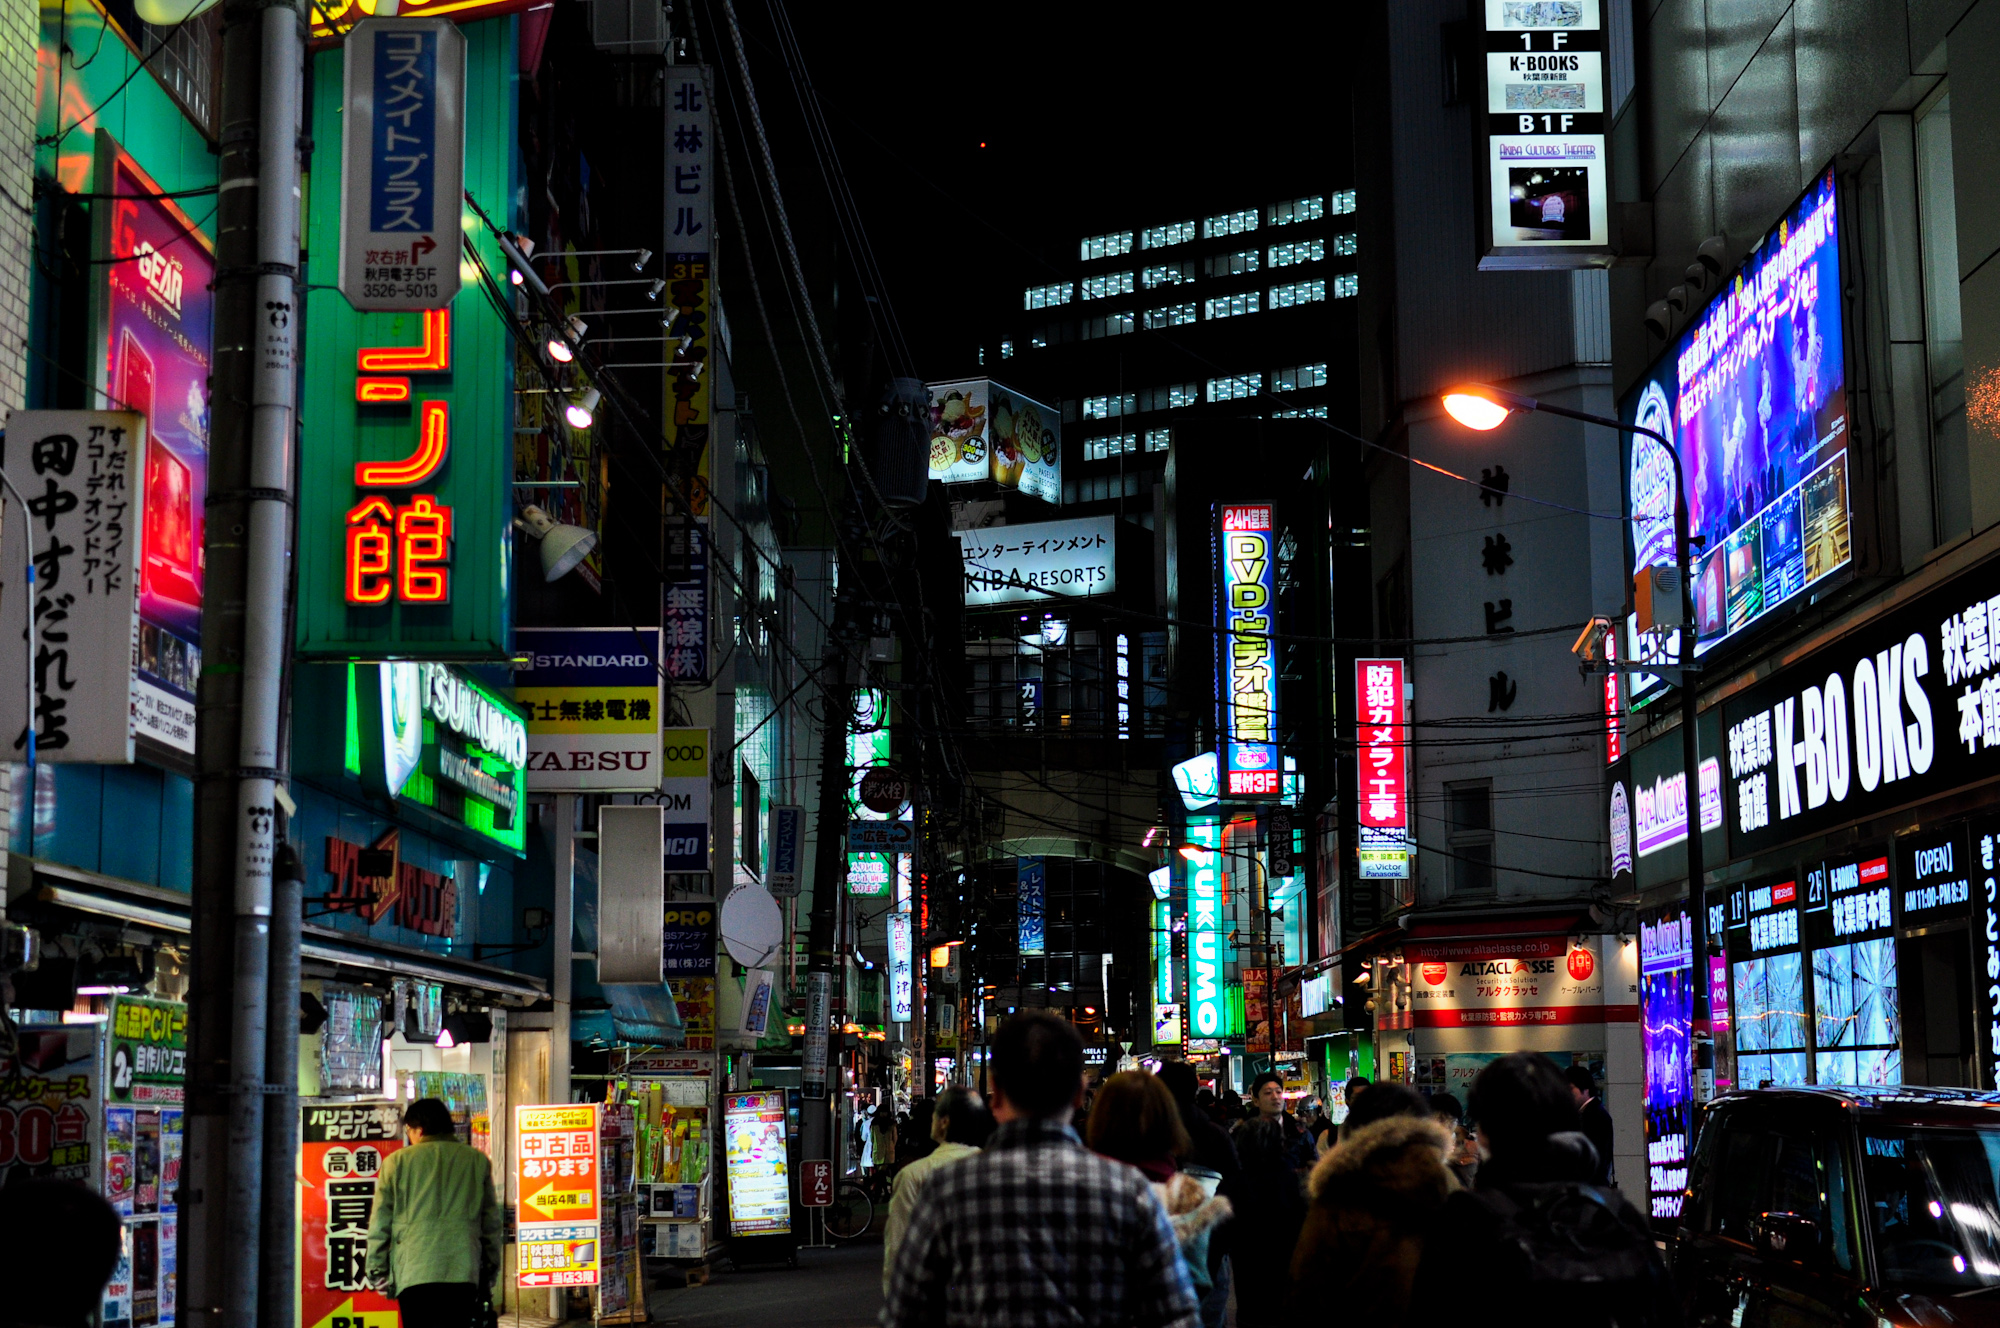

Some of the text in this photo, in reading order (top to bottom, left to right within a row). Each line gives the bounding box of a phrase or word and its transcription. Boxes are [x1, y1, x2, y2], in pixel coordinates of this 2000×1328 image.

[1510, 56, 1579, 71] K-BOOKS
[1523, 73, 1567, 81] 秋葉原新館
[380, 33, 424, 230] コスメイトプラス
[673, 83, 703, 236] 北林ビル
[1525, 144, 1560, 155] CULTURES
[1564, 143, 1596, 155] THEATER
[365, 251, 408, 266] 次右折
[364, 268, 436, 282] 秋月電子5F
[673, 264, 704, 279] 3F
[363, 283, 437, 298] 3526-5013
[83, 425, 105, 595] アコーデオンドアー
[104, 426, 127, 596] すだれ・ブラインド
[1225, 510, 1270, 529] 24H営業
[964, 533, 1106, 561] エンターテインメント
[1026, 565, 1106, 590] RESORTS
[14, 434, 78, 753] 田中すだれ店
[536, 655, 648, 668] STANDARD
[419, 662, 528, 771] TSUKUMO
[1774, 633, 1934, 820] K-BOOKS
[1366, 666, 1397, 821] 防犯カメラ・工事
[1728, 709, 1772, 779] 秋葉原
[864, 780, 902, 800] 消火栓
[1230, 772, 1277, 793] 受付3F
[1738, 772, 1769, 833] 新館
[1808, 870, 1823, 903] 2F
[1830, 863, 1859, 892] K-BOOKS
[1731, 891, 1743, 921] 1F
[1749, 886, 1772, 912] K-BOOKS
[1709, 904, 1725, 934] B1F
[1832, 887, 1892, 937] 秋葉原本館
[1193, 819, 1219, 1036] TSUKUMO
[1750, 908, 1799, 952] 秋葉原新館
[1420, 942, 1550, 958] http://www.altaclasse.co.jp
[1476, 986, 1538, 997] アルタクラッセ
[1561, 985, 1601, 995] ケーブル・パーツ
[1460, 1012, 1557, 1023] 秋葉原防犯・監視カメラ専門店
[685, 1037, 713, 1050] 買取
[136, 1046, 187, 1075] 自作パソコ
[310, 1109, 400, 1126] パソコン本体
[527, 1111, 588, 1120] パソコン・PCパーツ
[325, 1124, 397, 1140] PCパーツ
[524, 1134, 591, 1156] 中古品
[327, 1151, 378, 1173] 高額
[523, 1158, 594, 1178] あります
[814, 1164, 829, 1204] はんこ
[536, 1193, 577, 1206] 当店4階
[328, 1182, 376, 1287] 買取
[551, 1271, 595, 1285] 当店3階
